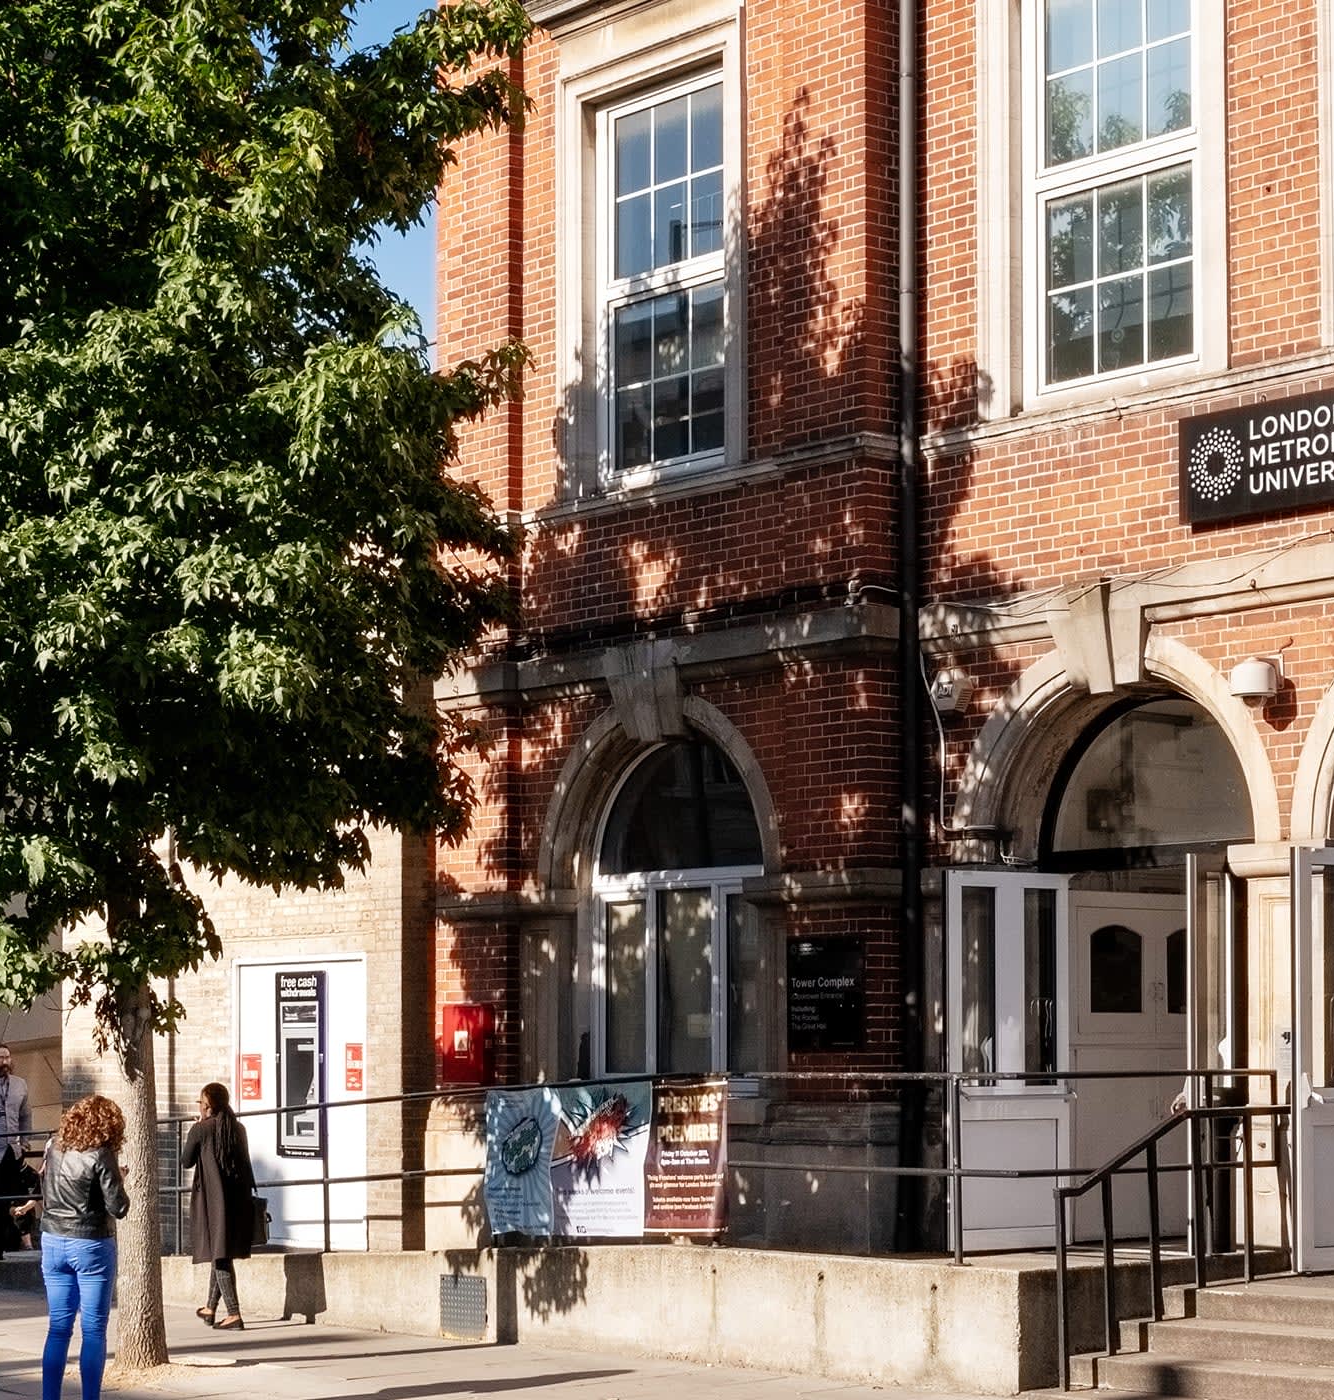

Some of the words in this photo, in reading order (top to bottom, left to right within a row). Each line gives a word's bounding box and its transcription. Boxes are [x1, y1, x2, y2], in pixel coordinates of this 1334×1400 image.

[280, 976, 297, 988] free
[298, 975, 317, 988] cash
[791, 977, 816, 989] Tower
[817, 976, 855, 990] Complex
[280, 987, 317, 997] withdrawals
[658, 1093, 722, 1113] FRESHERS'
[657, 1123, 719, 1143] PREMIERE
